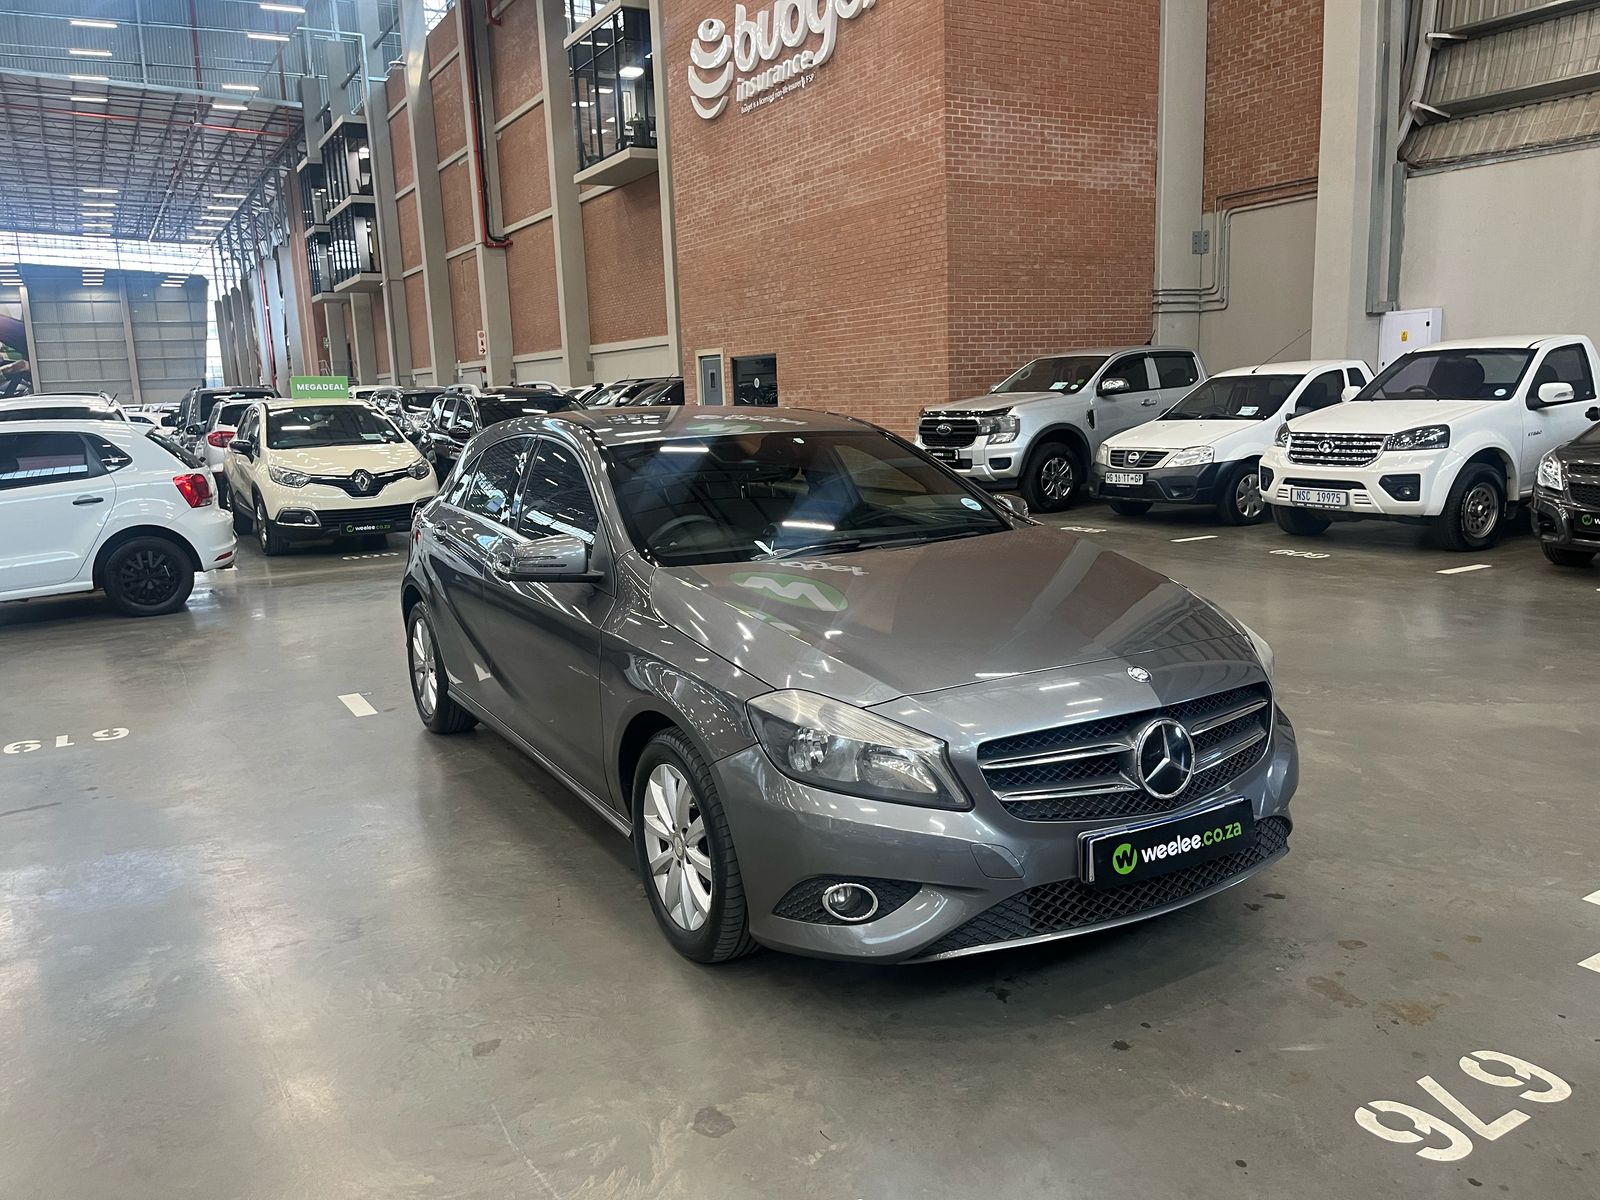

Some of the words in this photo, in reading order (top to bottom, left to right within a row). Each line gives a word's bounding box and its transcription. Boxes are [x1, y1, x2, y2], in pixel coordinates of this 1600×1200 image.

[736, 50, 816, 102] insurance
[296, 383, 344, 391] MEGADEAL
[1296, 490, 1311, 501] NSC
[1316, 492, 1341, 503] 19975
[3, 727, 130, 755] 619
[1141, 821, 1242, 863] weelee.co.za
[1354, 1049, 1573, 1162] 676
